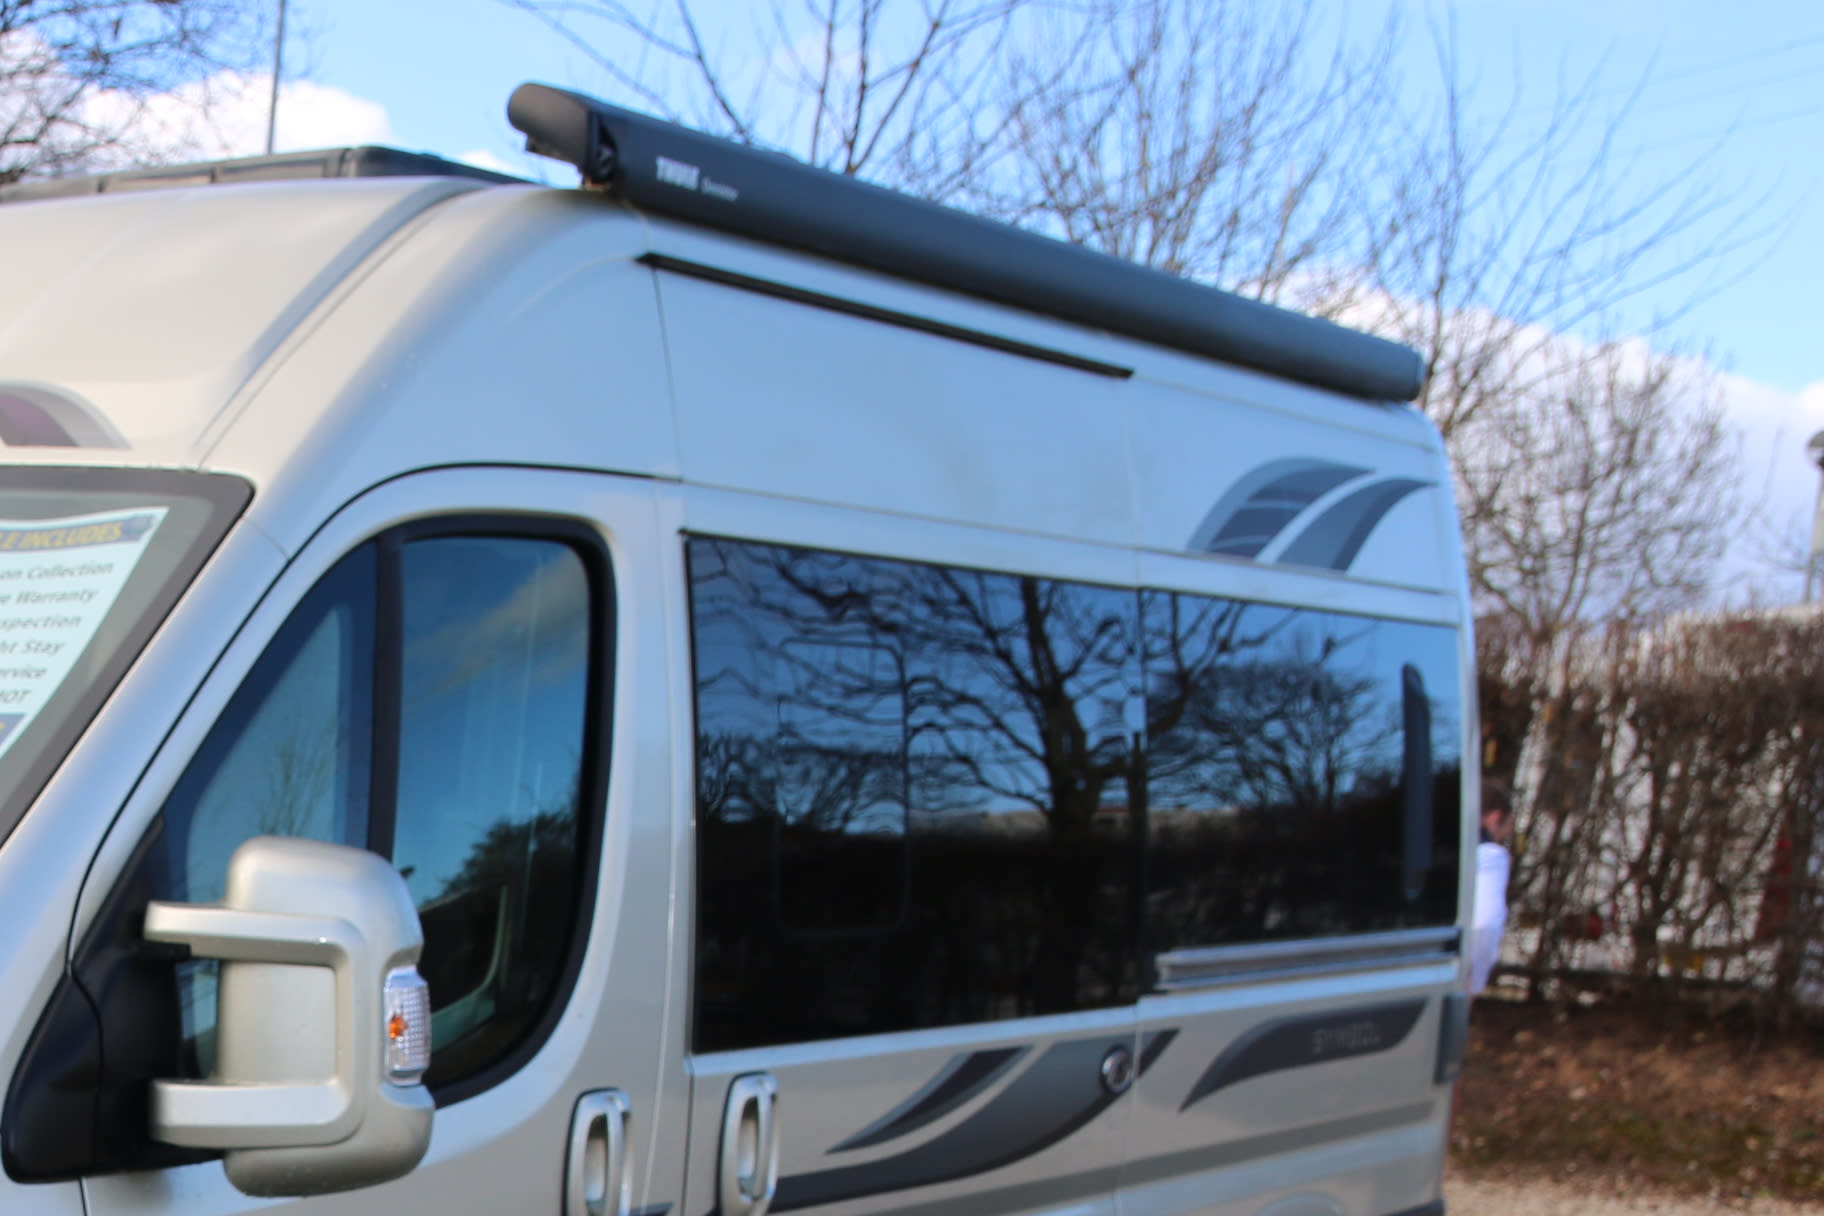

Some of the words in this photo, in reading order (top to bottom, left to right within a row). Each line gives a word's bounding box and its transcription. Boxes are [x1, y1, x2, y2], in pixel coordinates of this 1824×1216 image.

[20, 520, 124, 549] INCLUDES
[26, 560, 114, 580] Collection
[15, 589, 99, 605] Warranty
[23, 639, 65, 657] Stay
